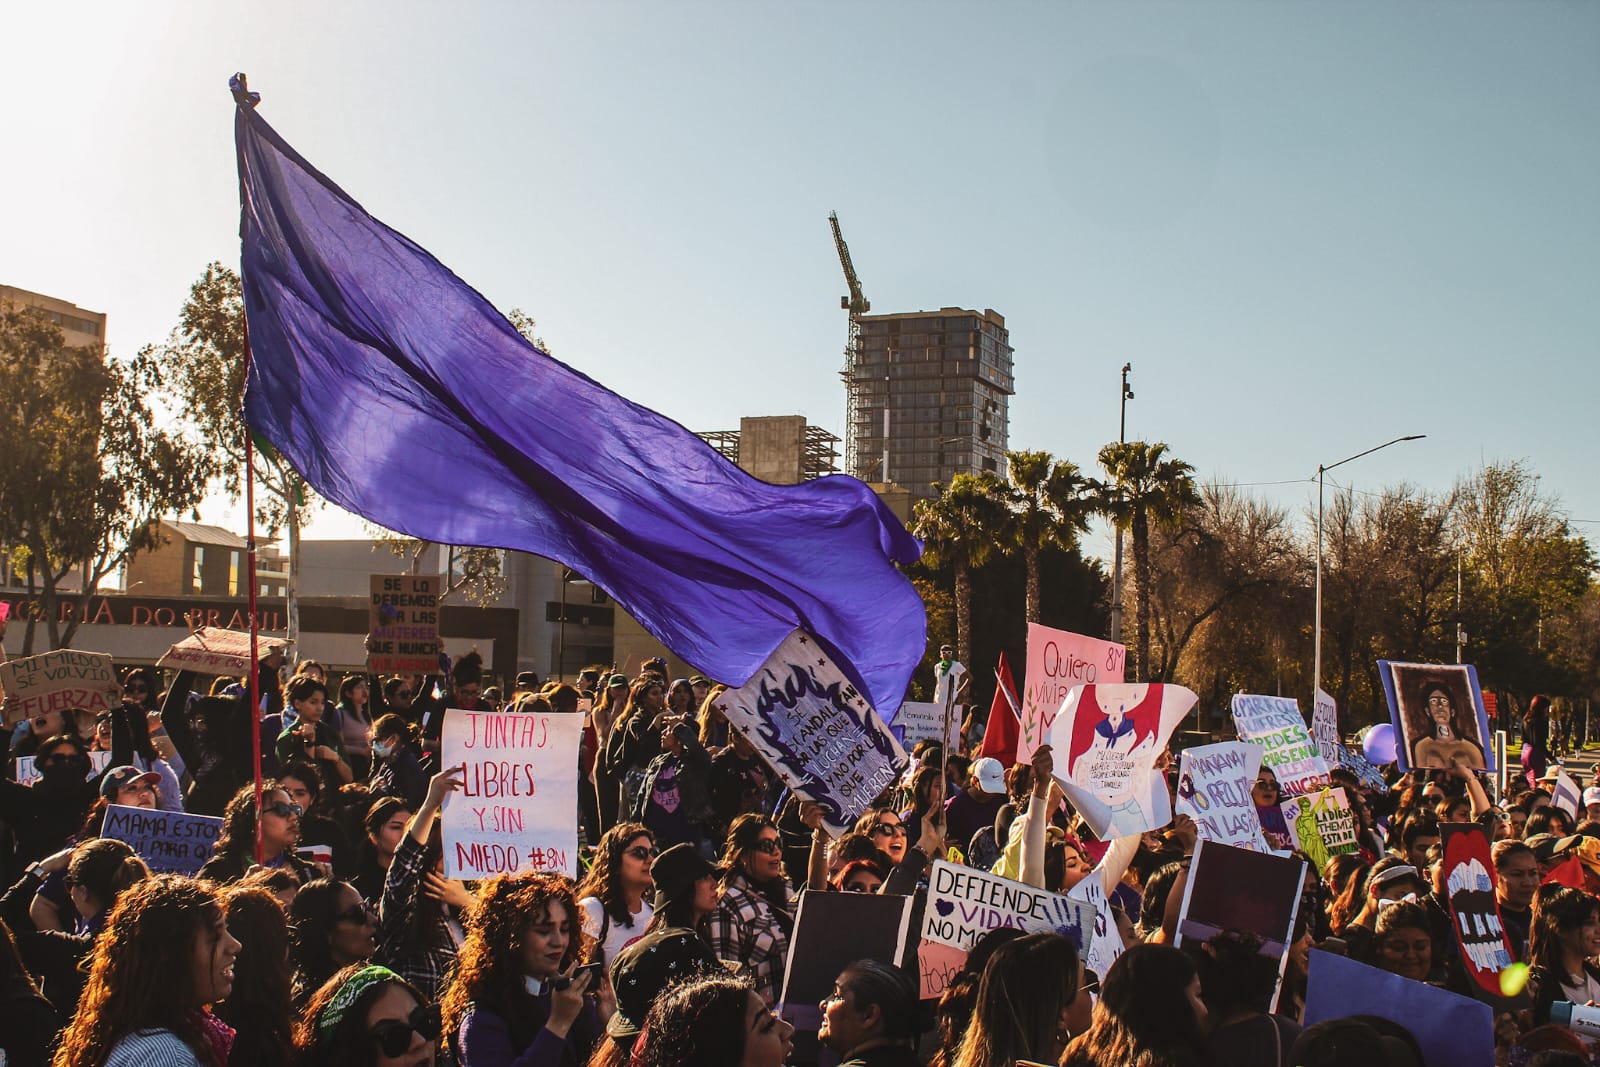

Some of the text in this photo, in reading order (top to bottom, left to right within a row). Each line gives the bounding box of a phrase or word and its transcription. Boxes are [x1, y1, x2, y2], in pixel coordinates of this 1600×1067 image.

[384, 578, 429, 593] SE LO
[373, 593, 437, 608] DEBEMOS
[130, 605, 176, 628] DO
[189, 607, 288, 633] BRAIL
[412, 612, 437, 625] LAS
[373, 627, 437, 640] MUJERES
[398, 642, 439, 655] NUNCA
[12, 653, 102, 676] MI MIEDO
[1044, 641, 1125, 684] Quiero 8M
[16, 674, 38, 689] SE
[24, 689, 108, 717] FUERZA
[785, 706, 807, 728] SE
[812, 737, 828, 755] LAS
[827, 715, 850, 738] QUE
[813, 734, 857, 776] LUCHAN
[835, 762, 850, 782] NO
[847, 744, 868, 766] POR
[462, 761, 536, 798] LIBRES
[838, 771, 864, 798] QUE
[847, 762, 896, 818] MUEREN
[107, 812, 169, 837] MAMÁ
[472, 805, 524, 834] Y SIN
[1316, 812, 1328, 822] LA
[150, 840, 189, 859] PARA
[1323, 830, 1353, 846] ESTA DE
[455, 842, 568, 874] MIEDO #8M
[936, 867, 1048, 921] DEFIENDE
[927, 917, 954, 940] NO
[959, 901, 1027, 932] VIDAS
